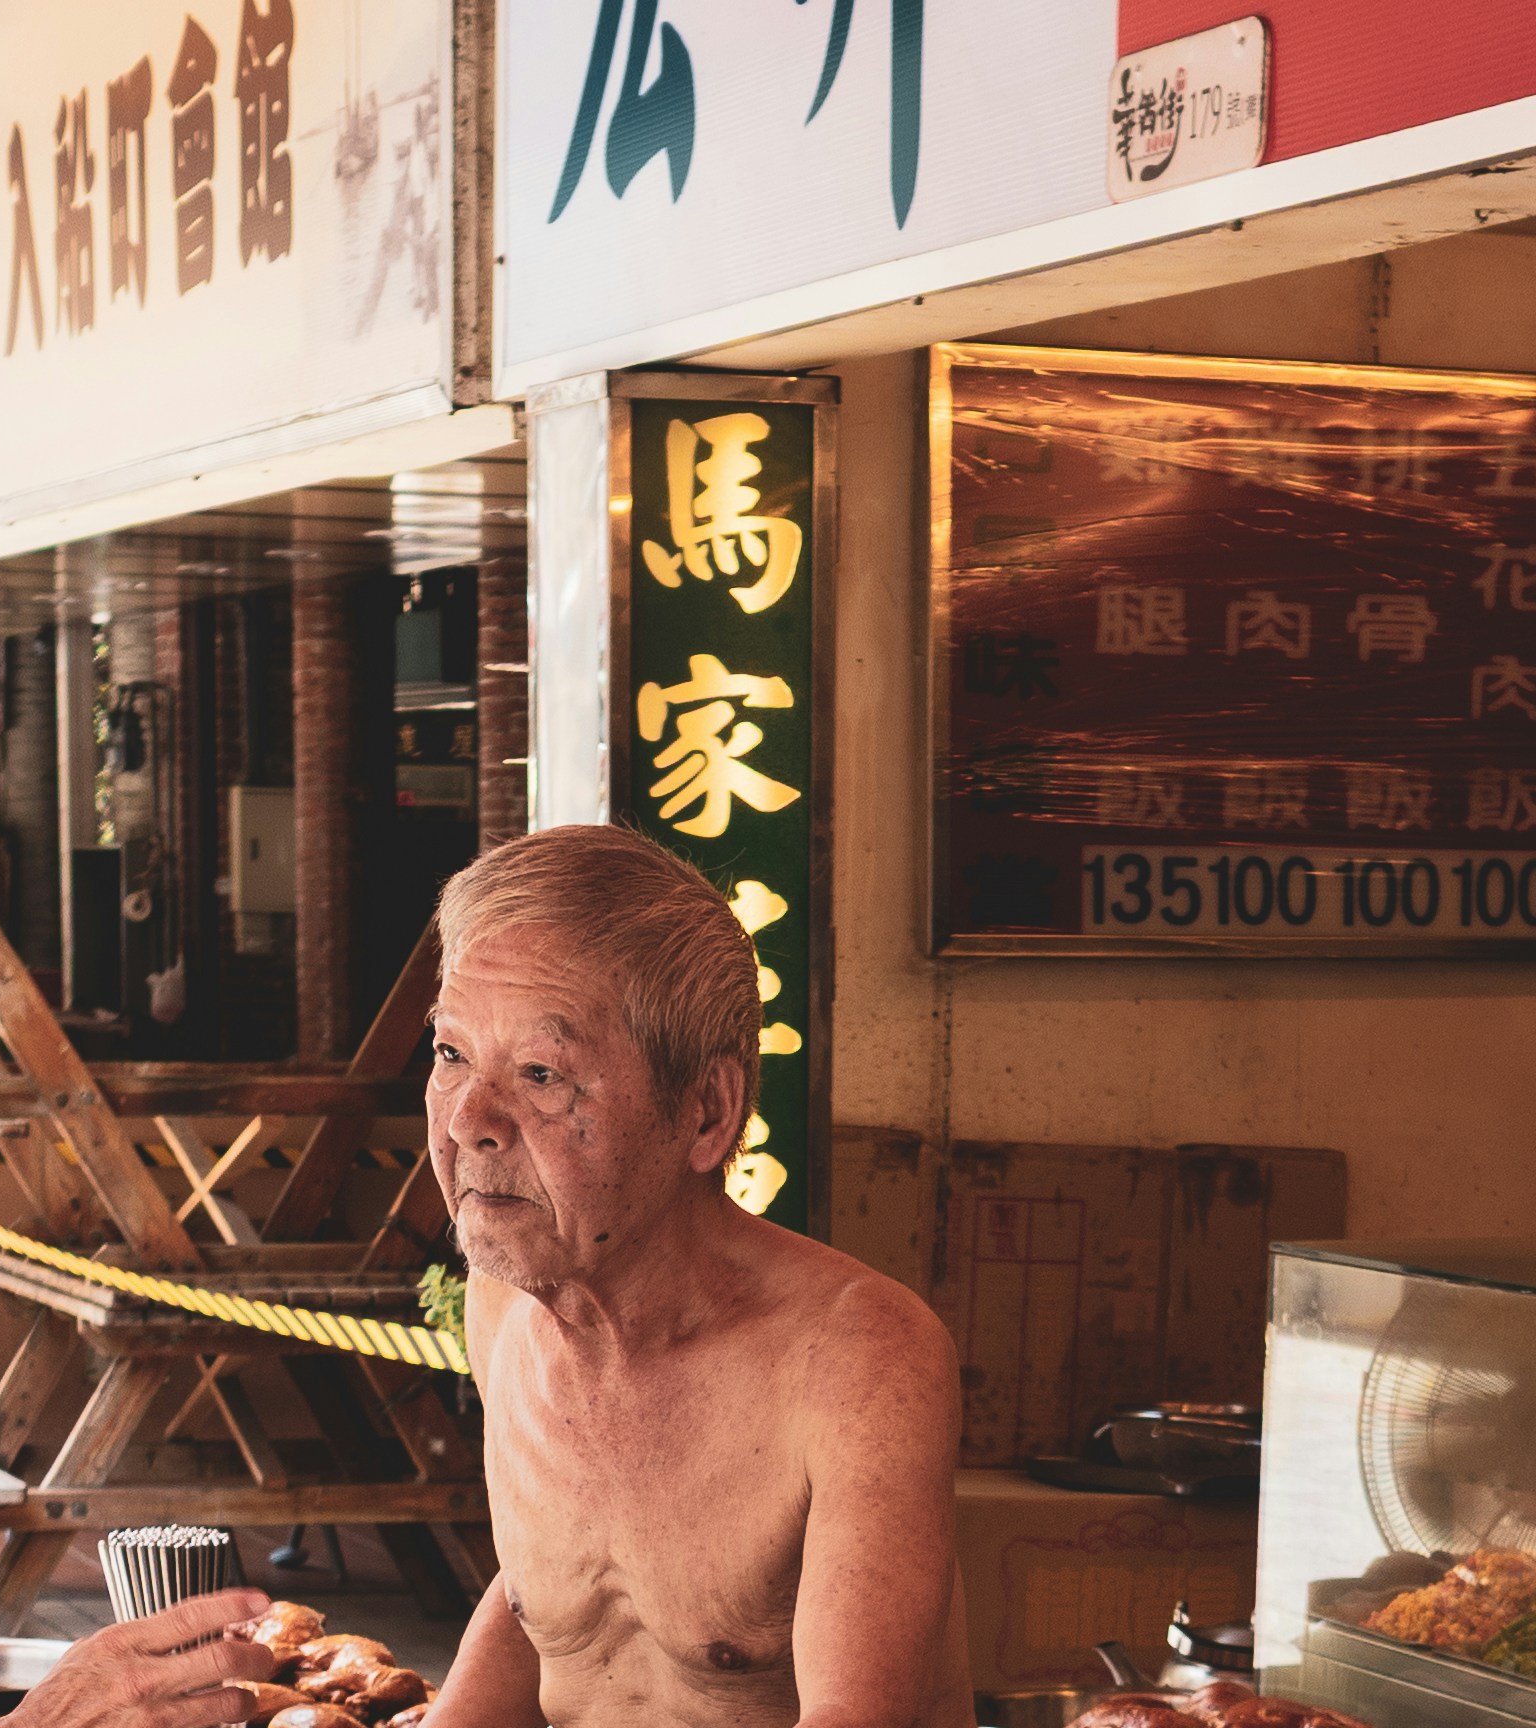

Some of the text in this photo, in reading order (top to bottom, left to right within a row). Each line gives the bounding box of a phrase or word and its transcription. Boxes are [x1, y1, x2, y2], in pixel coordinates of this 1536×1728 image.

[1083, 853, 1200, 926] 135
[1209, 855, 1315, 928] 100
[1340, 857, 1439, 928] 100
